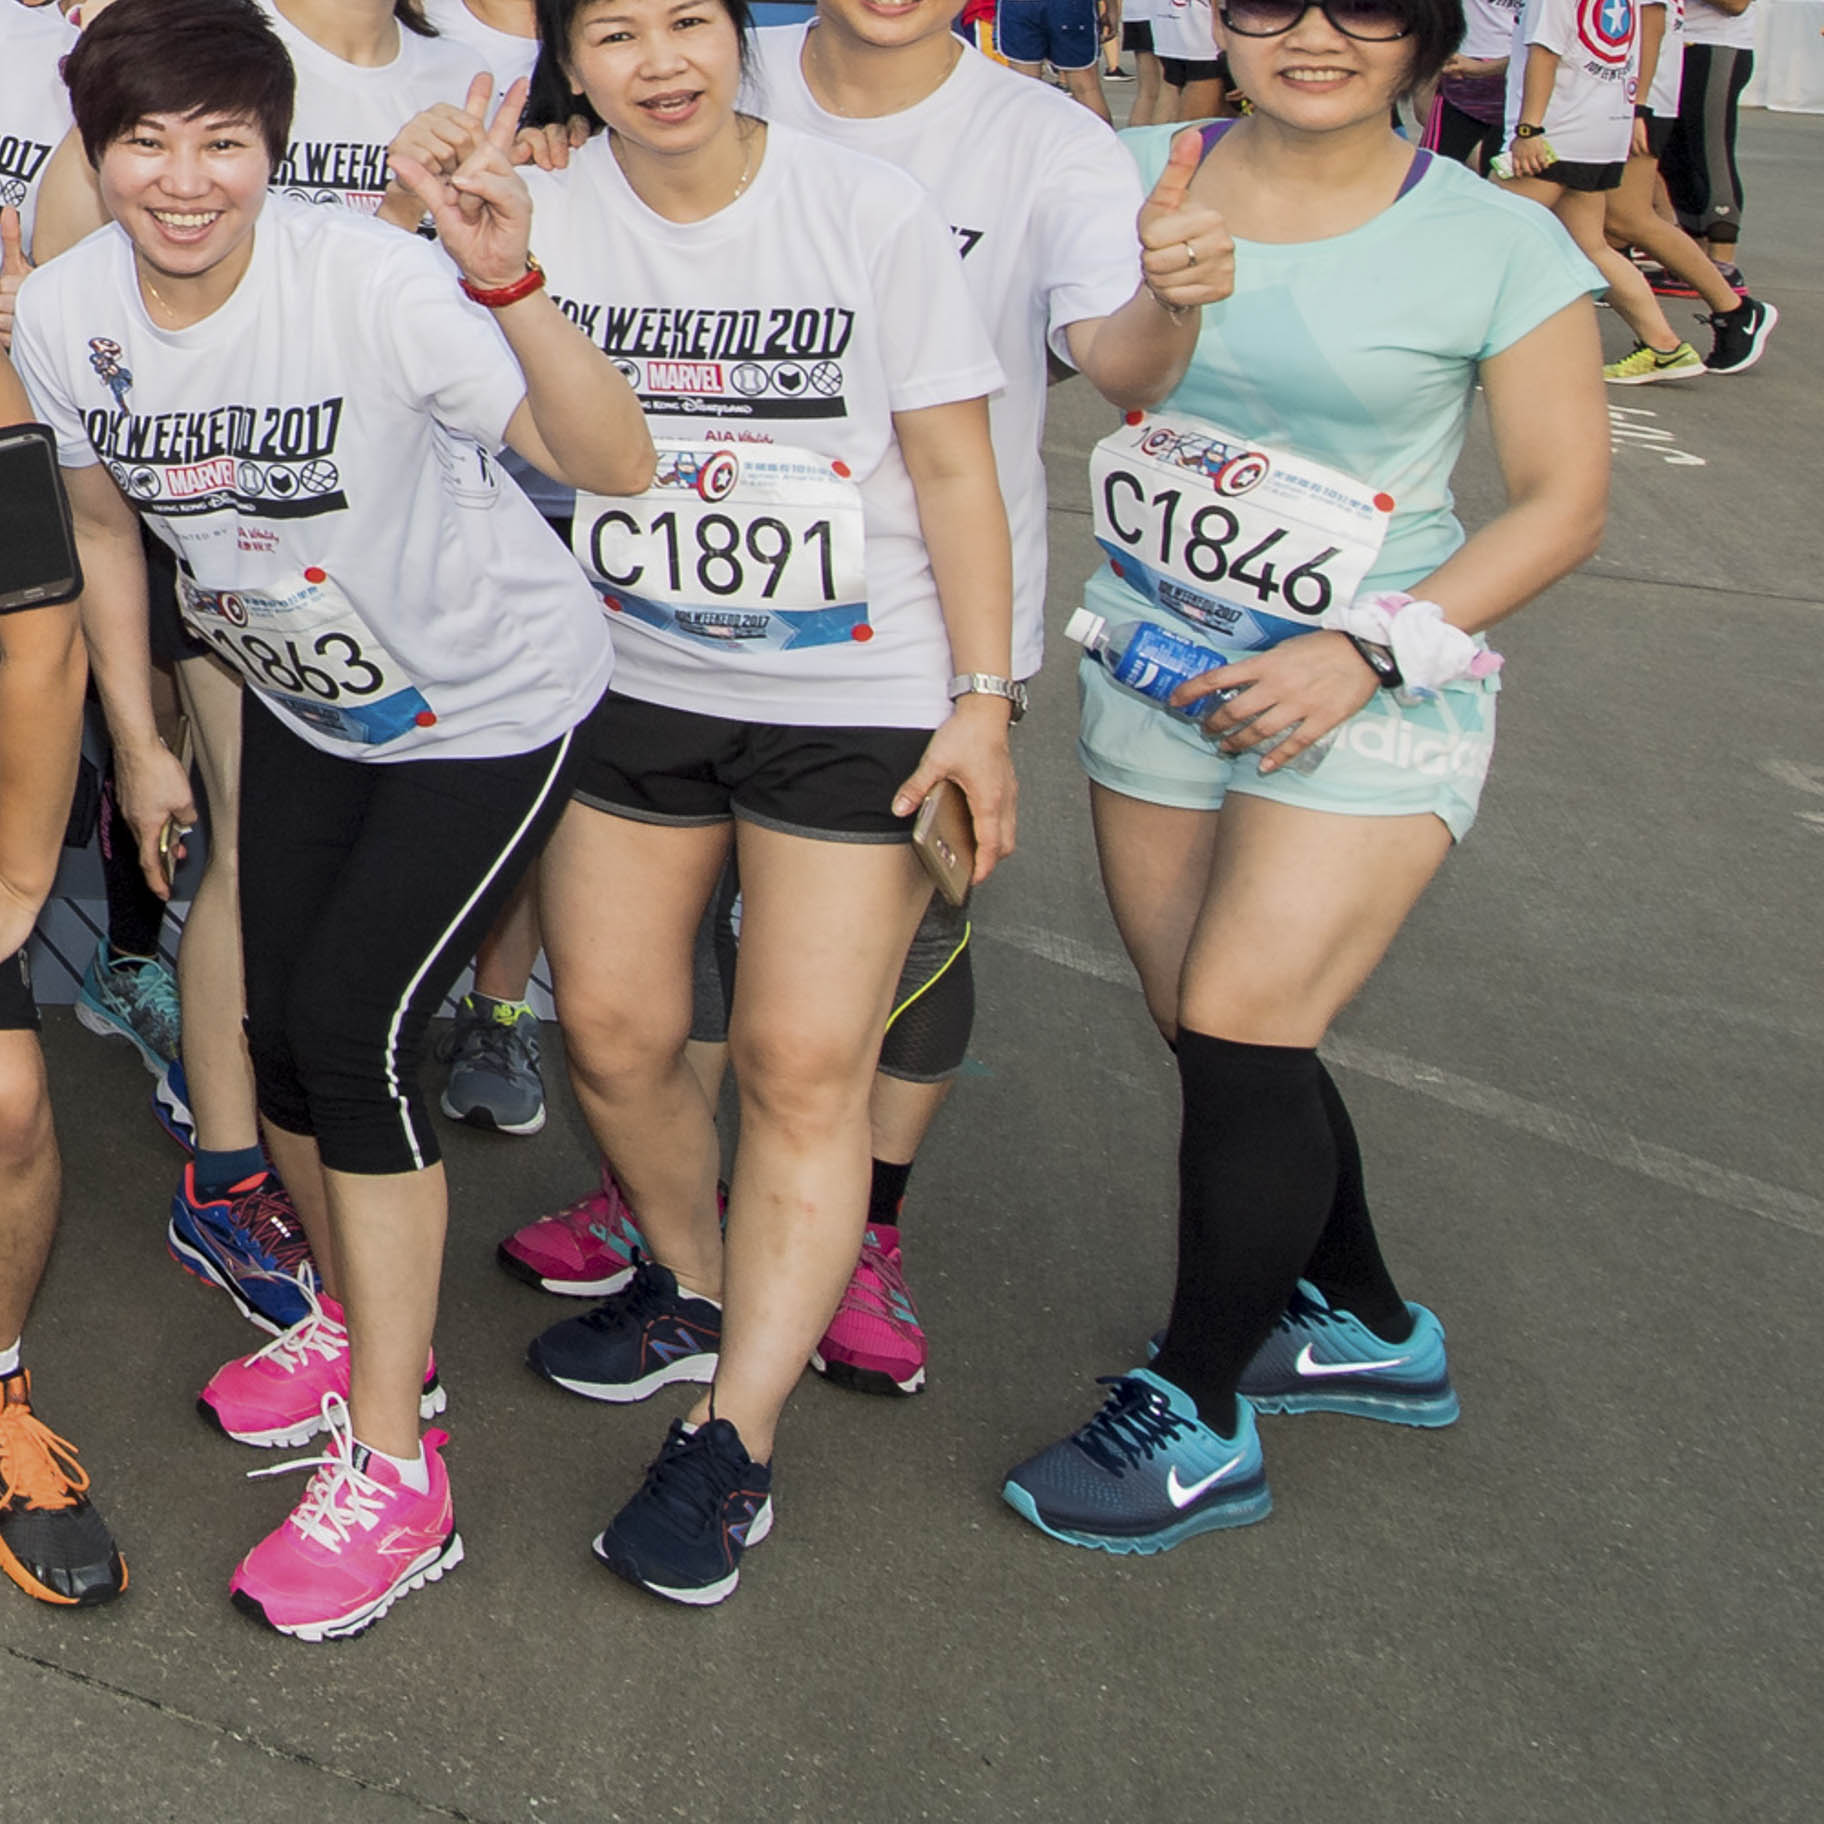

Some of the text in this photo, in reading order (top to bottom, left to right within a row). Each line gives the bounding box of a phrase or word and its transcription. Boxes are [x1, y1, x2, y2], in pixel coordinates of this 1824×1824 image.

[950, 226, 985, 260] 7
[602, 307, 761, 360] WEEKEND
[763, 307, 856, 360] 2017
[649, 363, 724, 393] MARVEL
[80, 397, 344, 465] 0K WEEKEND 2017
[704, 429, 736, 443] AIA
[590, 509, 838, 603] C1891
[1103, 470, 1342, 617] C1846
[741, 613, 772, 629] 2017
